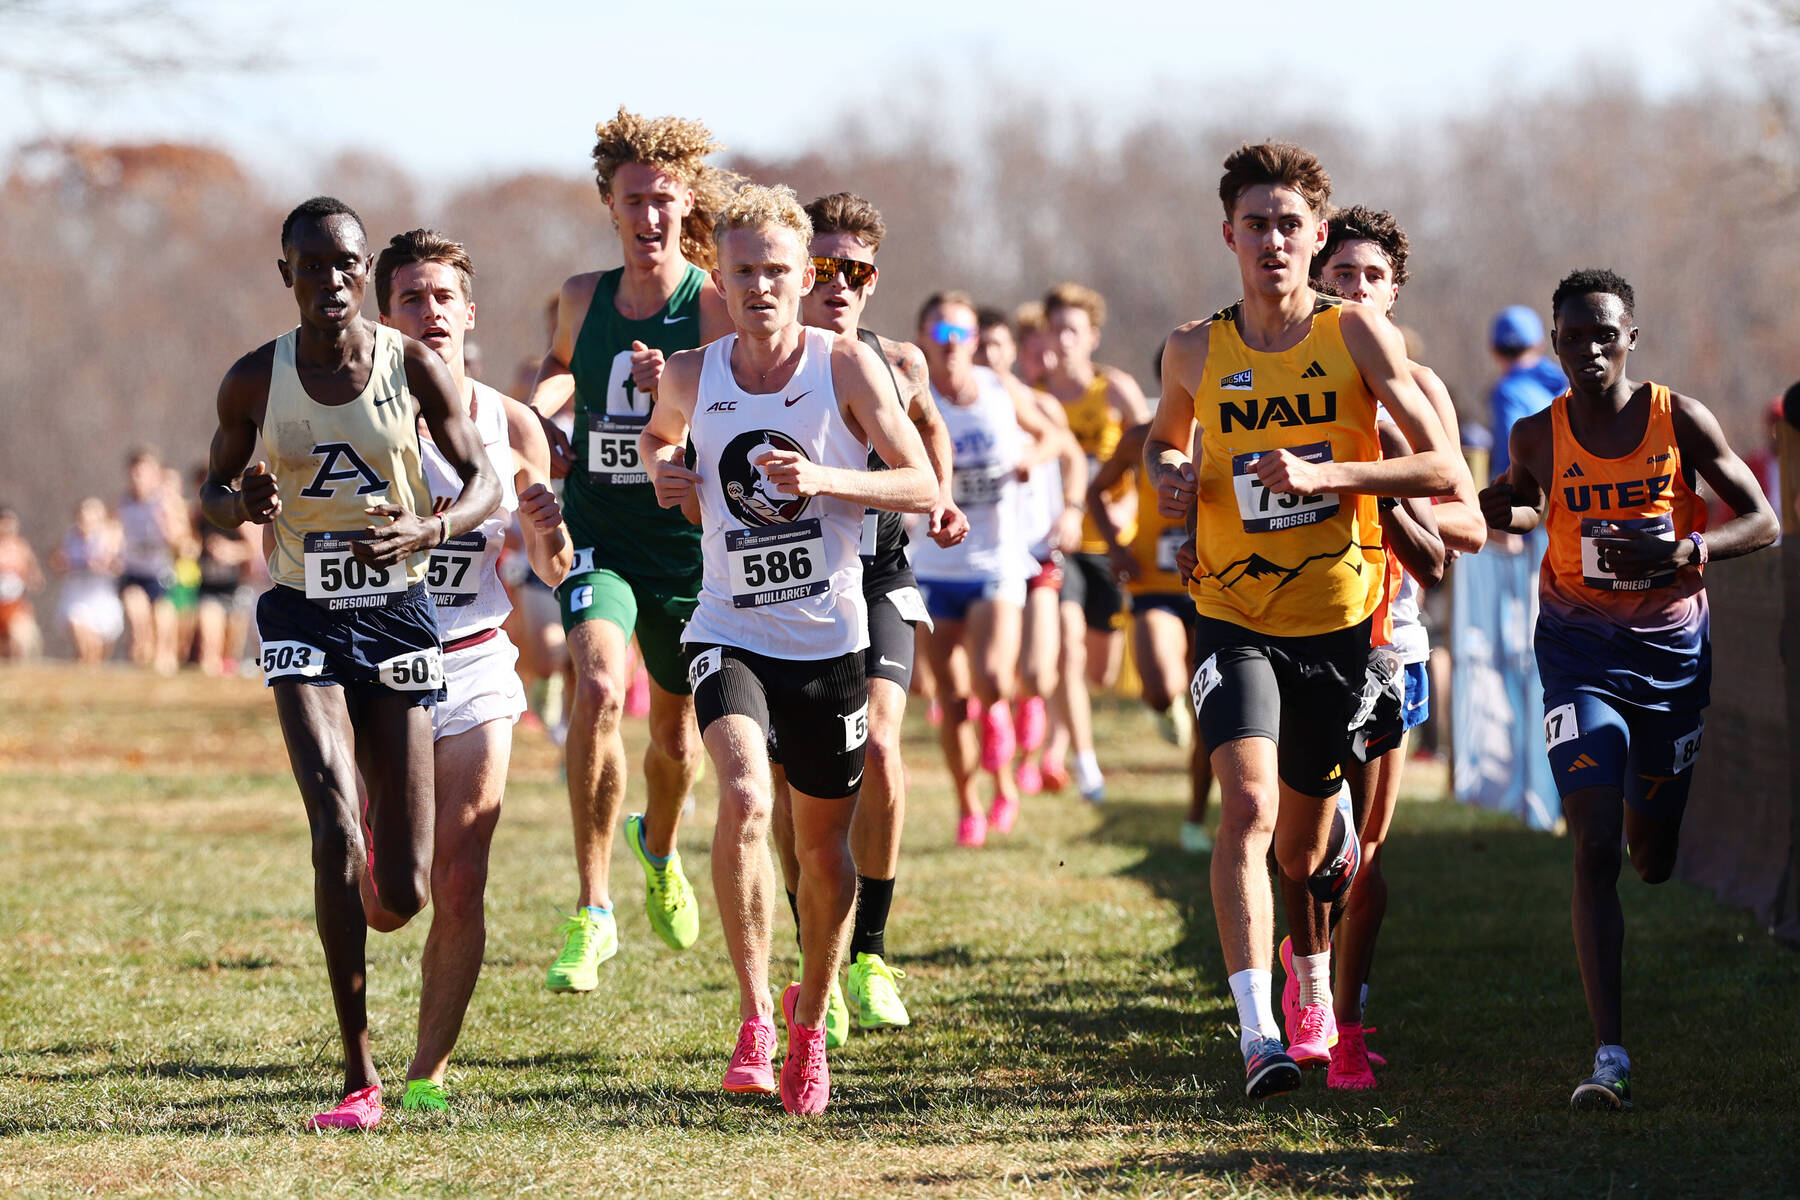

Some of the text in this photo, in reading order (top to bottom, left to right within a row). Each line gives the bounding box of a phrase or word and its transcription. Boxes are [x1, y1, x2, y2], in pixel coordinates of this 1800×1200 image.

[1233, 371, 1251, 384] SKY
[707, 401, 738, 412] ACC
[1218, 391, 1337, 433] NAU
[300, 442, 391, 499] A
[612, 474, 649, 484] SCUDDE
[1564, 474, 1671, 512] UTEP
[1270, 512, 1317, 530] PROSSER
[759, 534, 777, 543] COUNTRY
[777, 529, 812, 540] CHAMPIONSHIPS
[320, 555, 390, 592] 503
[743, 547, 812, 587] 586
[1612, 579, 1652, 591] KIBIEGO
[329, 594, 388, 610] CHESONDIN
[433, 593, 456, 605] ANEY
[755, 585, 812, 605] MULLARKEY
[264, 646, 312, 673] 503
